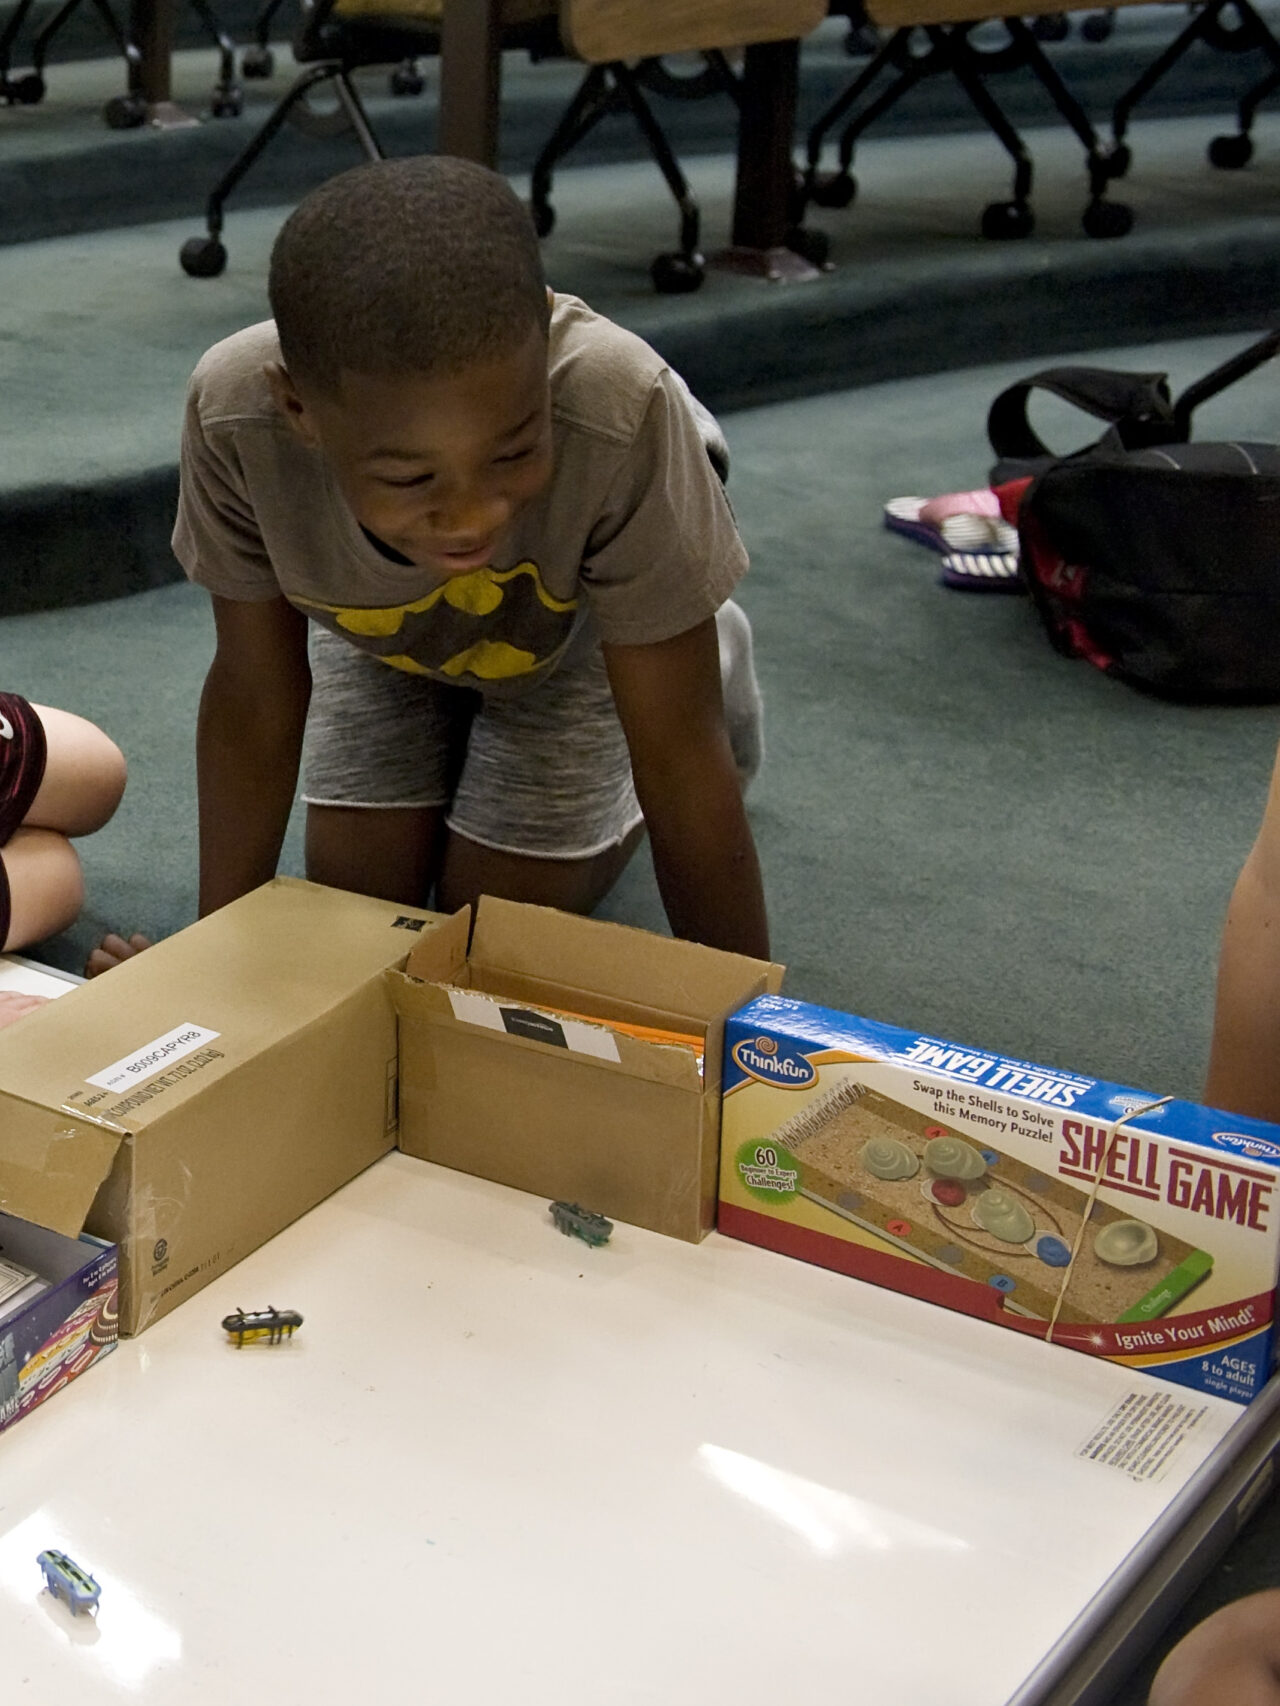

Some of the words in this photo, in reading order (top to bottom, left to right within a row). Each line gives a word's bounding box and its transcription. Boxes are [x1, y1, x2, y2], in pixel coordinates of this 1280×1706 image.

[905, 1040, 996, 1077] GAME
[913, 1080, 943, 1099] Swap
[947, 1089, 965, 1104] the
[969, 1095, 1004, 1114] Shells
[1007, 1106, 1019, 1118] to
[1022, 1110, 1055, 1128] Solve
[985, 1067, 1087, 1107] SHELL
[933, 1101, 956, 1116] this
[959, 1107, 1007, 1133] Memory
[1010, 1122, 1053, 1144] Puzzle!
[755, 1147, 777, 1167] 60
[1059, 1119, 1161, 1191] SHELL
[746, 1175, 794, 1191] Challenges!
[1167, 1159, 1273, 1232] GAME
[1114, 1332, 1164, 1350] Ignite
[1164, 1324, 1205, 1342] Your
[1206, 1308, 1256, 1334] Mind!
[1201, 1360, 1210, 1372] 8
[1211, 1363, 1223, 1377] to
[1225, 1370, 1256, 1387] adult
[1221, 1354, 1257, 1375] AGES
